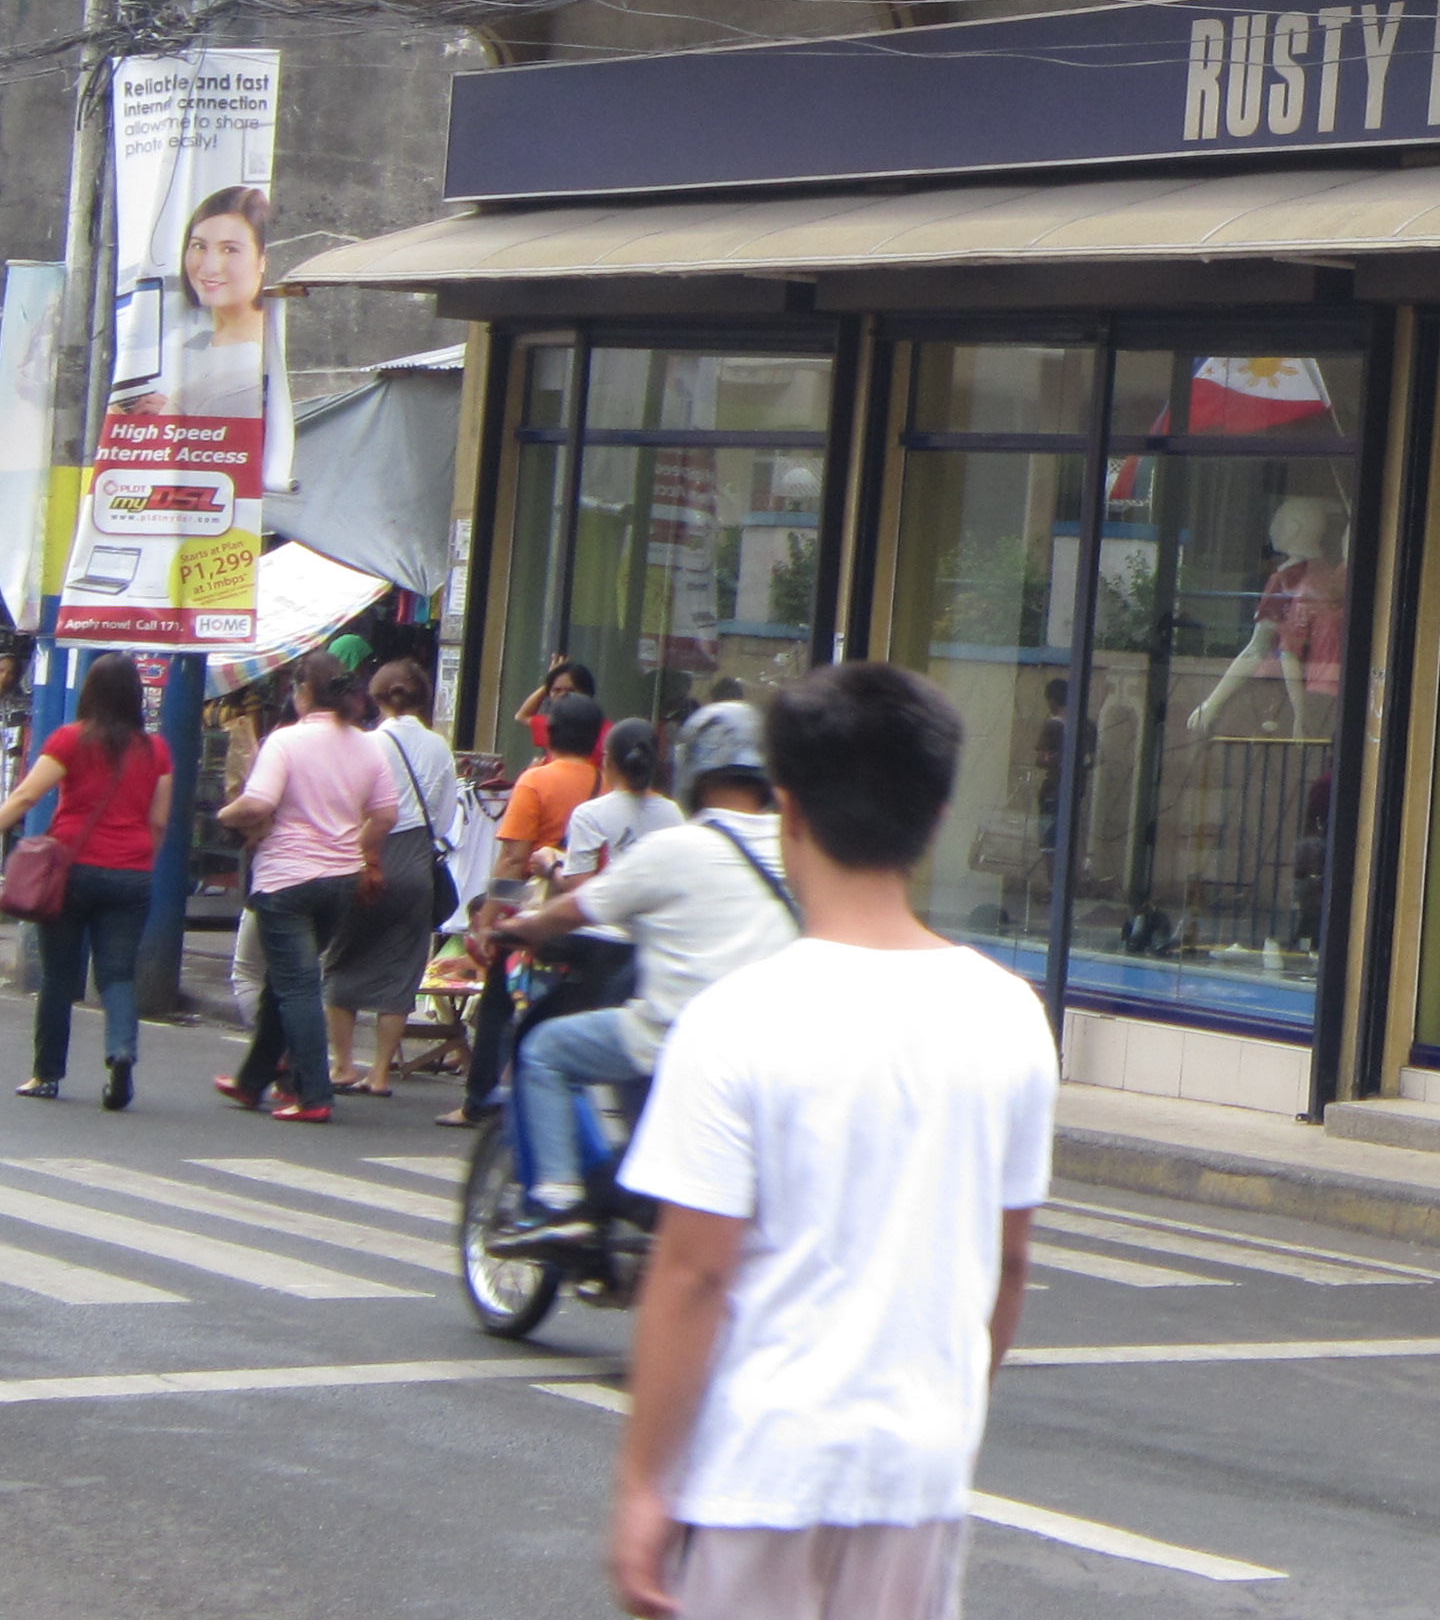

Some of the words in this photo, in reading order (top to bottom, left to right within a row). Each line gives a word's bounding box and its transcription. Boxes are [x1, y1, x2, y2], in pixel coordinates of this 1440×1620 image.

[1183, 1, 1405, 141] RUSTY
[197, 73, 231, 90] and
[236, 73, 270, 90] fast
[177, 96, 268, 111] connection
[194, 115, 210, 129] to
[215, 115, 260, 129] share
[110, 423, 159, 443] High
[163, 424, 228, 442] Speed
[175, 447, 249, 464] Access
[210, 546, 220, 555] at
[222, 541, 244, 551] Plan
[180, 549, 253, 584] P1,299
[193, 585, 204, 594] at
[64, 618, 99, 631] Apply
[102, 619, 131, 630] now!
[136, 619, 157, 630] Call
[200, 618, 248, 631] HOME
